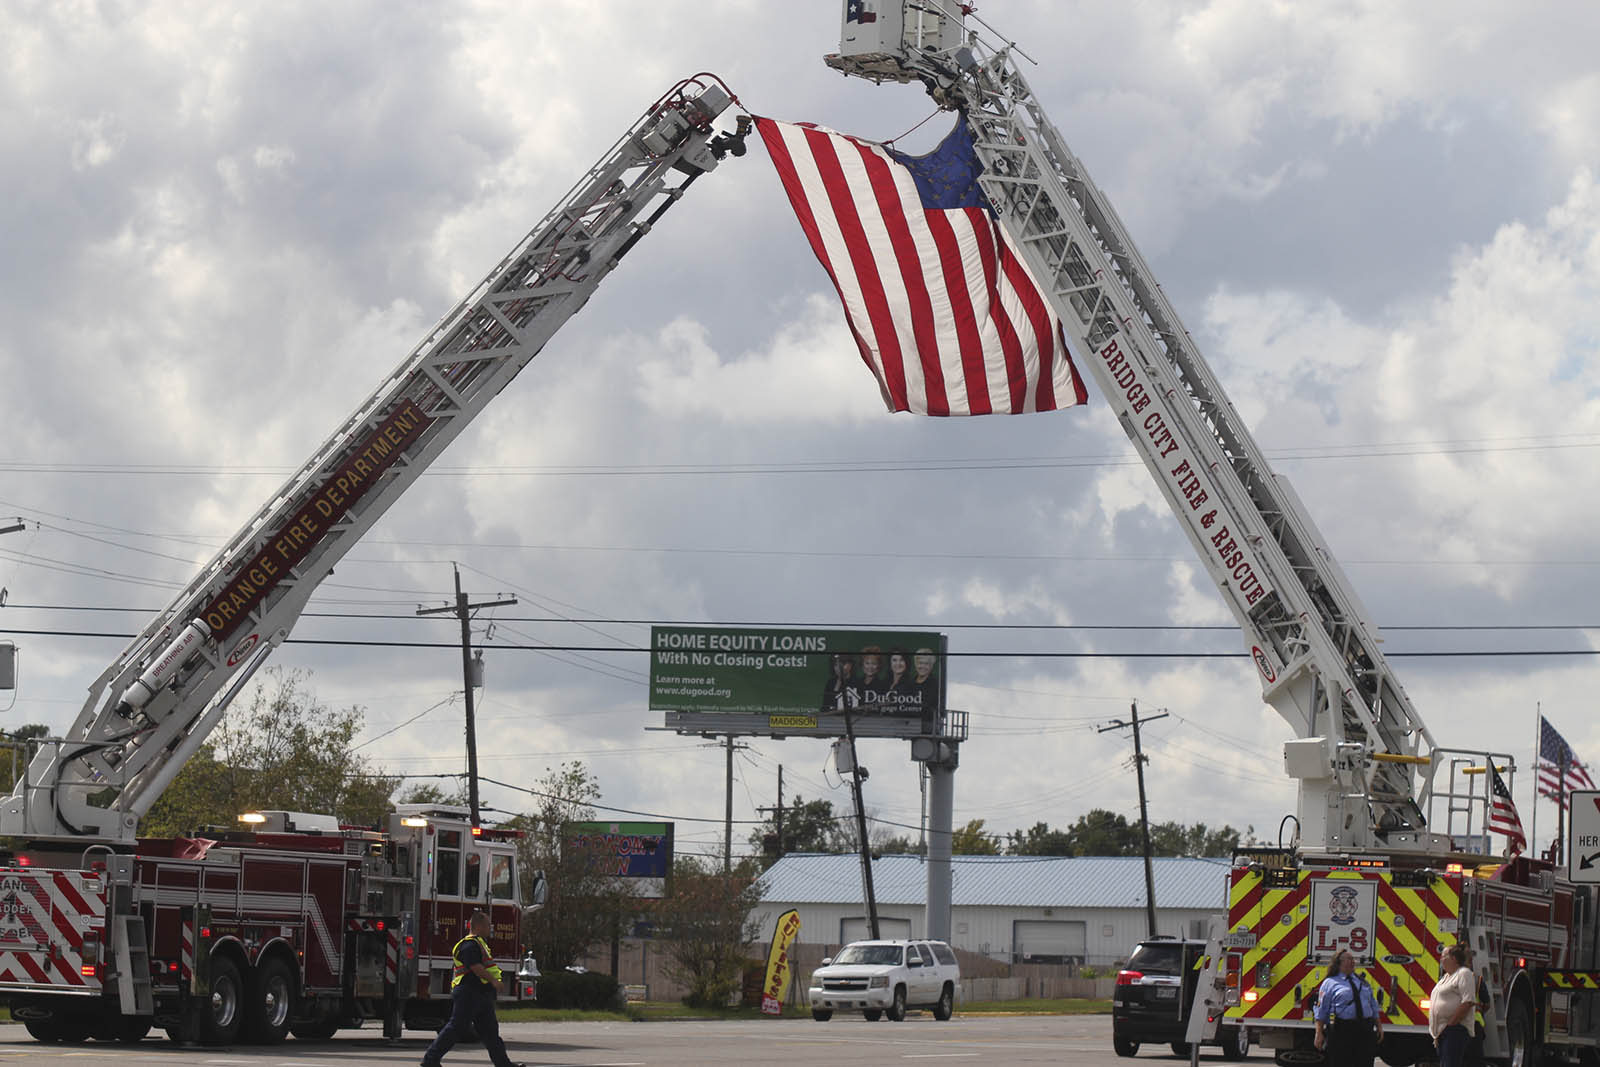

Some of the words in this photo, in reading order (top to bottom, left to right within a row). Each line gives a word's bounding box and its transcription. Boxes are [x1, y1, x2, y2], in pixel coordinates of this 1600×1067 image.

[1100, 339, 1151, 415] BRIDGE
[1143, 412, 1180, 459] CITY
[1170, 458, 1209, 511] FIRE
[1199, 509, 1218, 529] &
[1210, 525, 1266, 606] RESCUE
[207, 556, 278, 631] ORANGE
[275, 514, 319, 559] FIRE
[315, 406, 421, 517] DEPARTMENT
[657, 633, 706, 649] HOME
[710, 635, 768, 651] EQUITY
[772, 636, 827, 651] LOANS
[152, 645, 185, 678] BREATHING
[182, 633, 195, 645] AIR
[657, 651, 688, 665] With
[692, 652, 711, 666] No
[714, 653, 764, 669] Closing
[767, 654, 807, 668] Costs!
[656, 675, 680, 684] Learn
[682, 676, 704, 685] more
[705, 677, 715, 685] at
[656, 686, 731, 698] www.dugood.org
[864, 690, 922, 704] DuGood
[770, 716, 817, 727] MADDISON
[1579, 835, 1600, 847] HER
[1315, 925, 1369, 953] L-8
